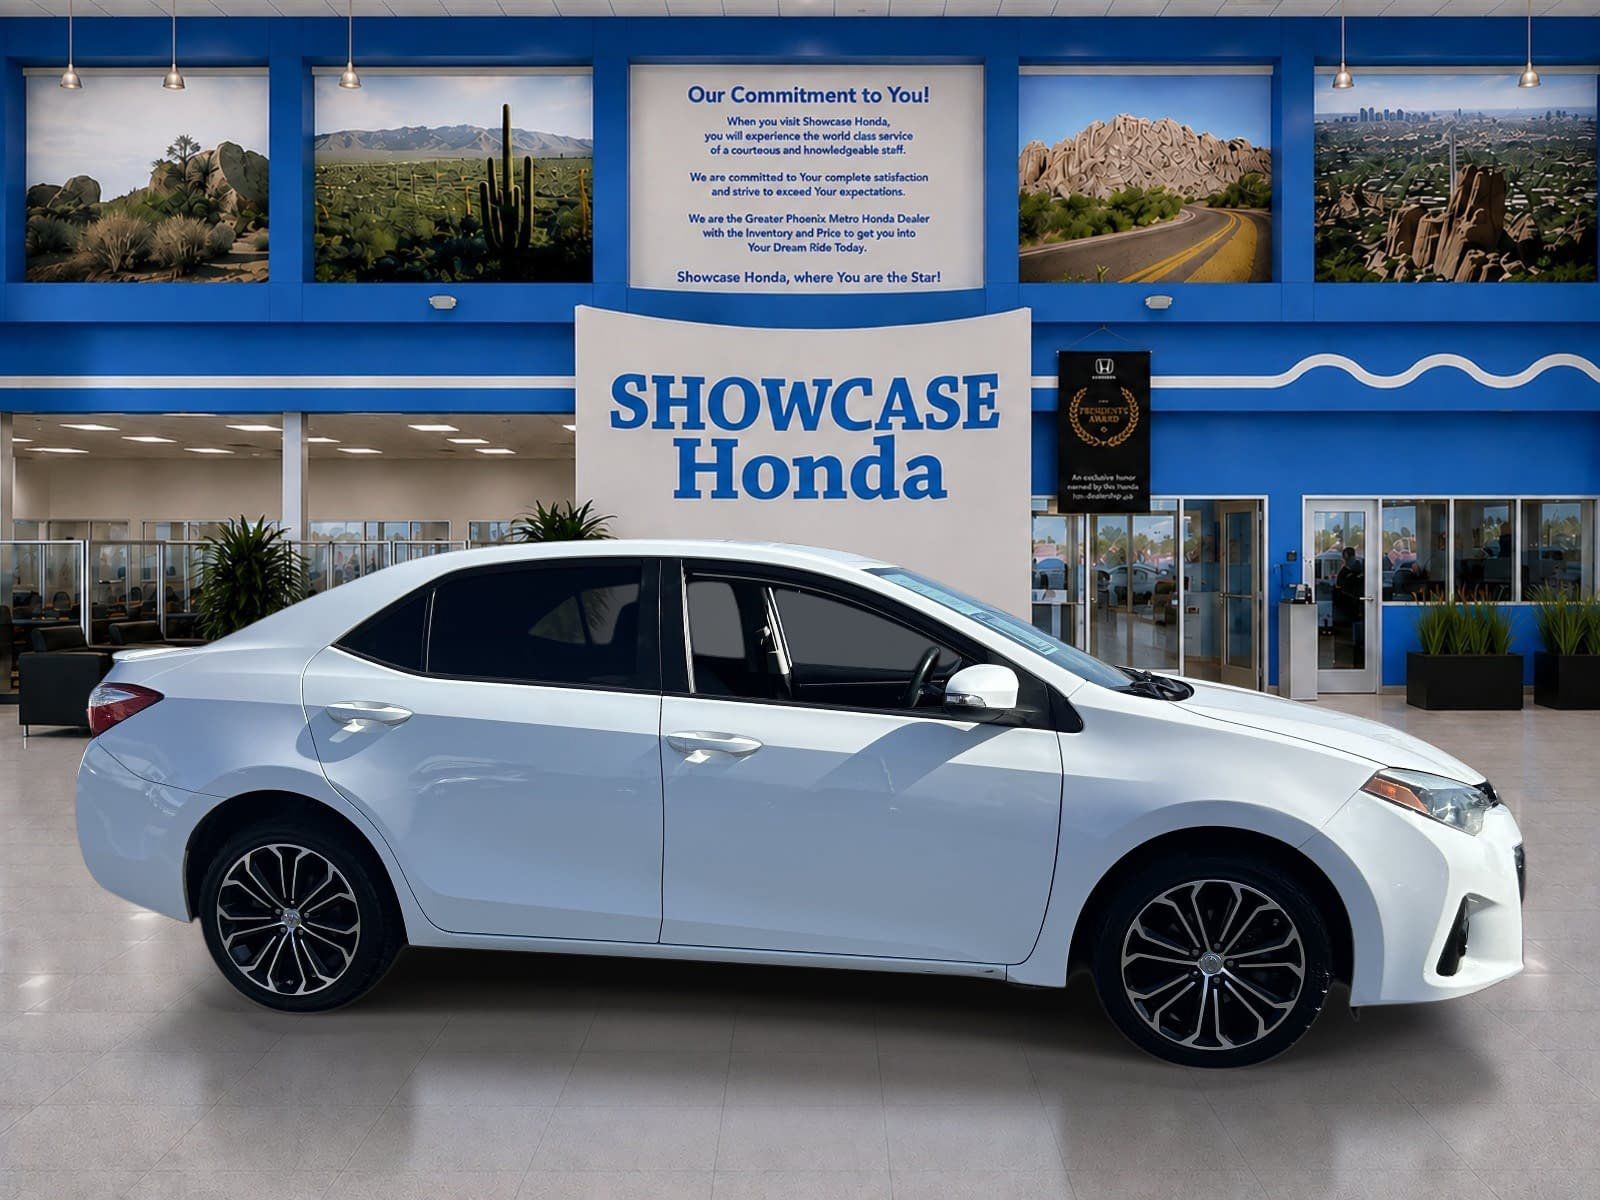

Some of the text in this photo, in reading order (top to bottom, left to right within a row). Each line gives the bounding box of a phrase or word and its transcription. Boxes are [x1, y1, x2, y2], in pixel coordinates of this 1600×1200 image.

[687, 85, 930, 104] Our Commitment to You!
[726, 115, 891, 129] When you visit Showcase Honda,
[704, 130, 914, 144] you will experience the world class service
[709, 144, 721, 155] of
[722, 147, 730, 155] a
[730, 146, 782, 156] courteous
[782, 144, 802, 155] and
[689, 171, 929, 185] We are committed to Your complete satisfaction
[711, 185, 906, 200] and strive to exceed Your expectations.
[688, 213, 931, 224] We are the Greater Phoenix Metro Honda Dealer
[702, 227, 917, 241] with the Inventory and Price to get you into
[747, 242, 868, 255] Your Dream Ride Today.
[676, 270, 941, 286] Showcase Honda, where You are the Star!
[610, 373, 1000, 431] SHOWCASE
[673, 434, 948, 500] Honda
